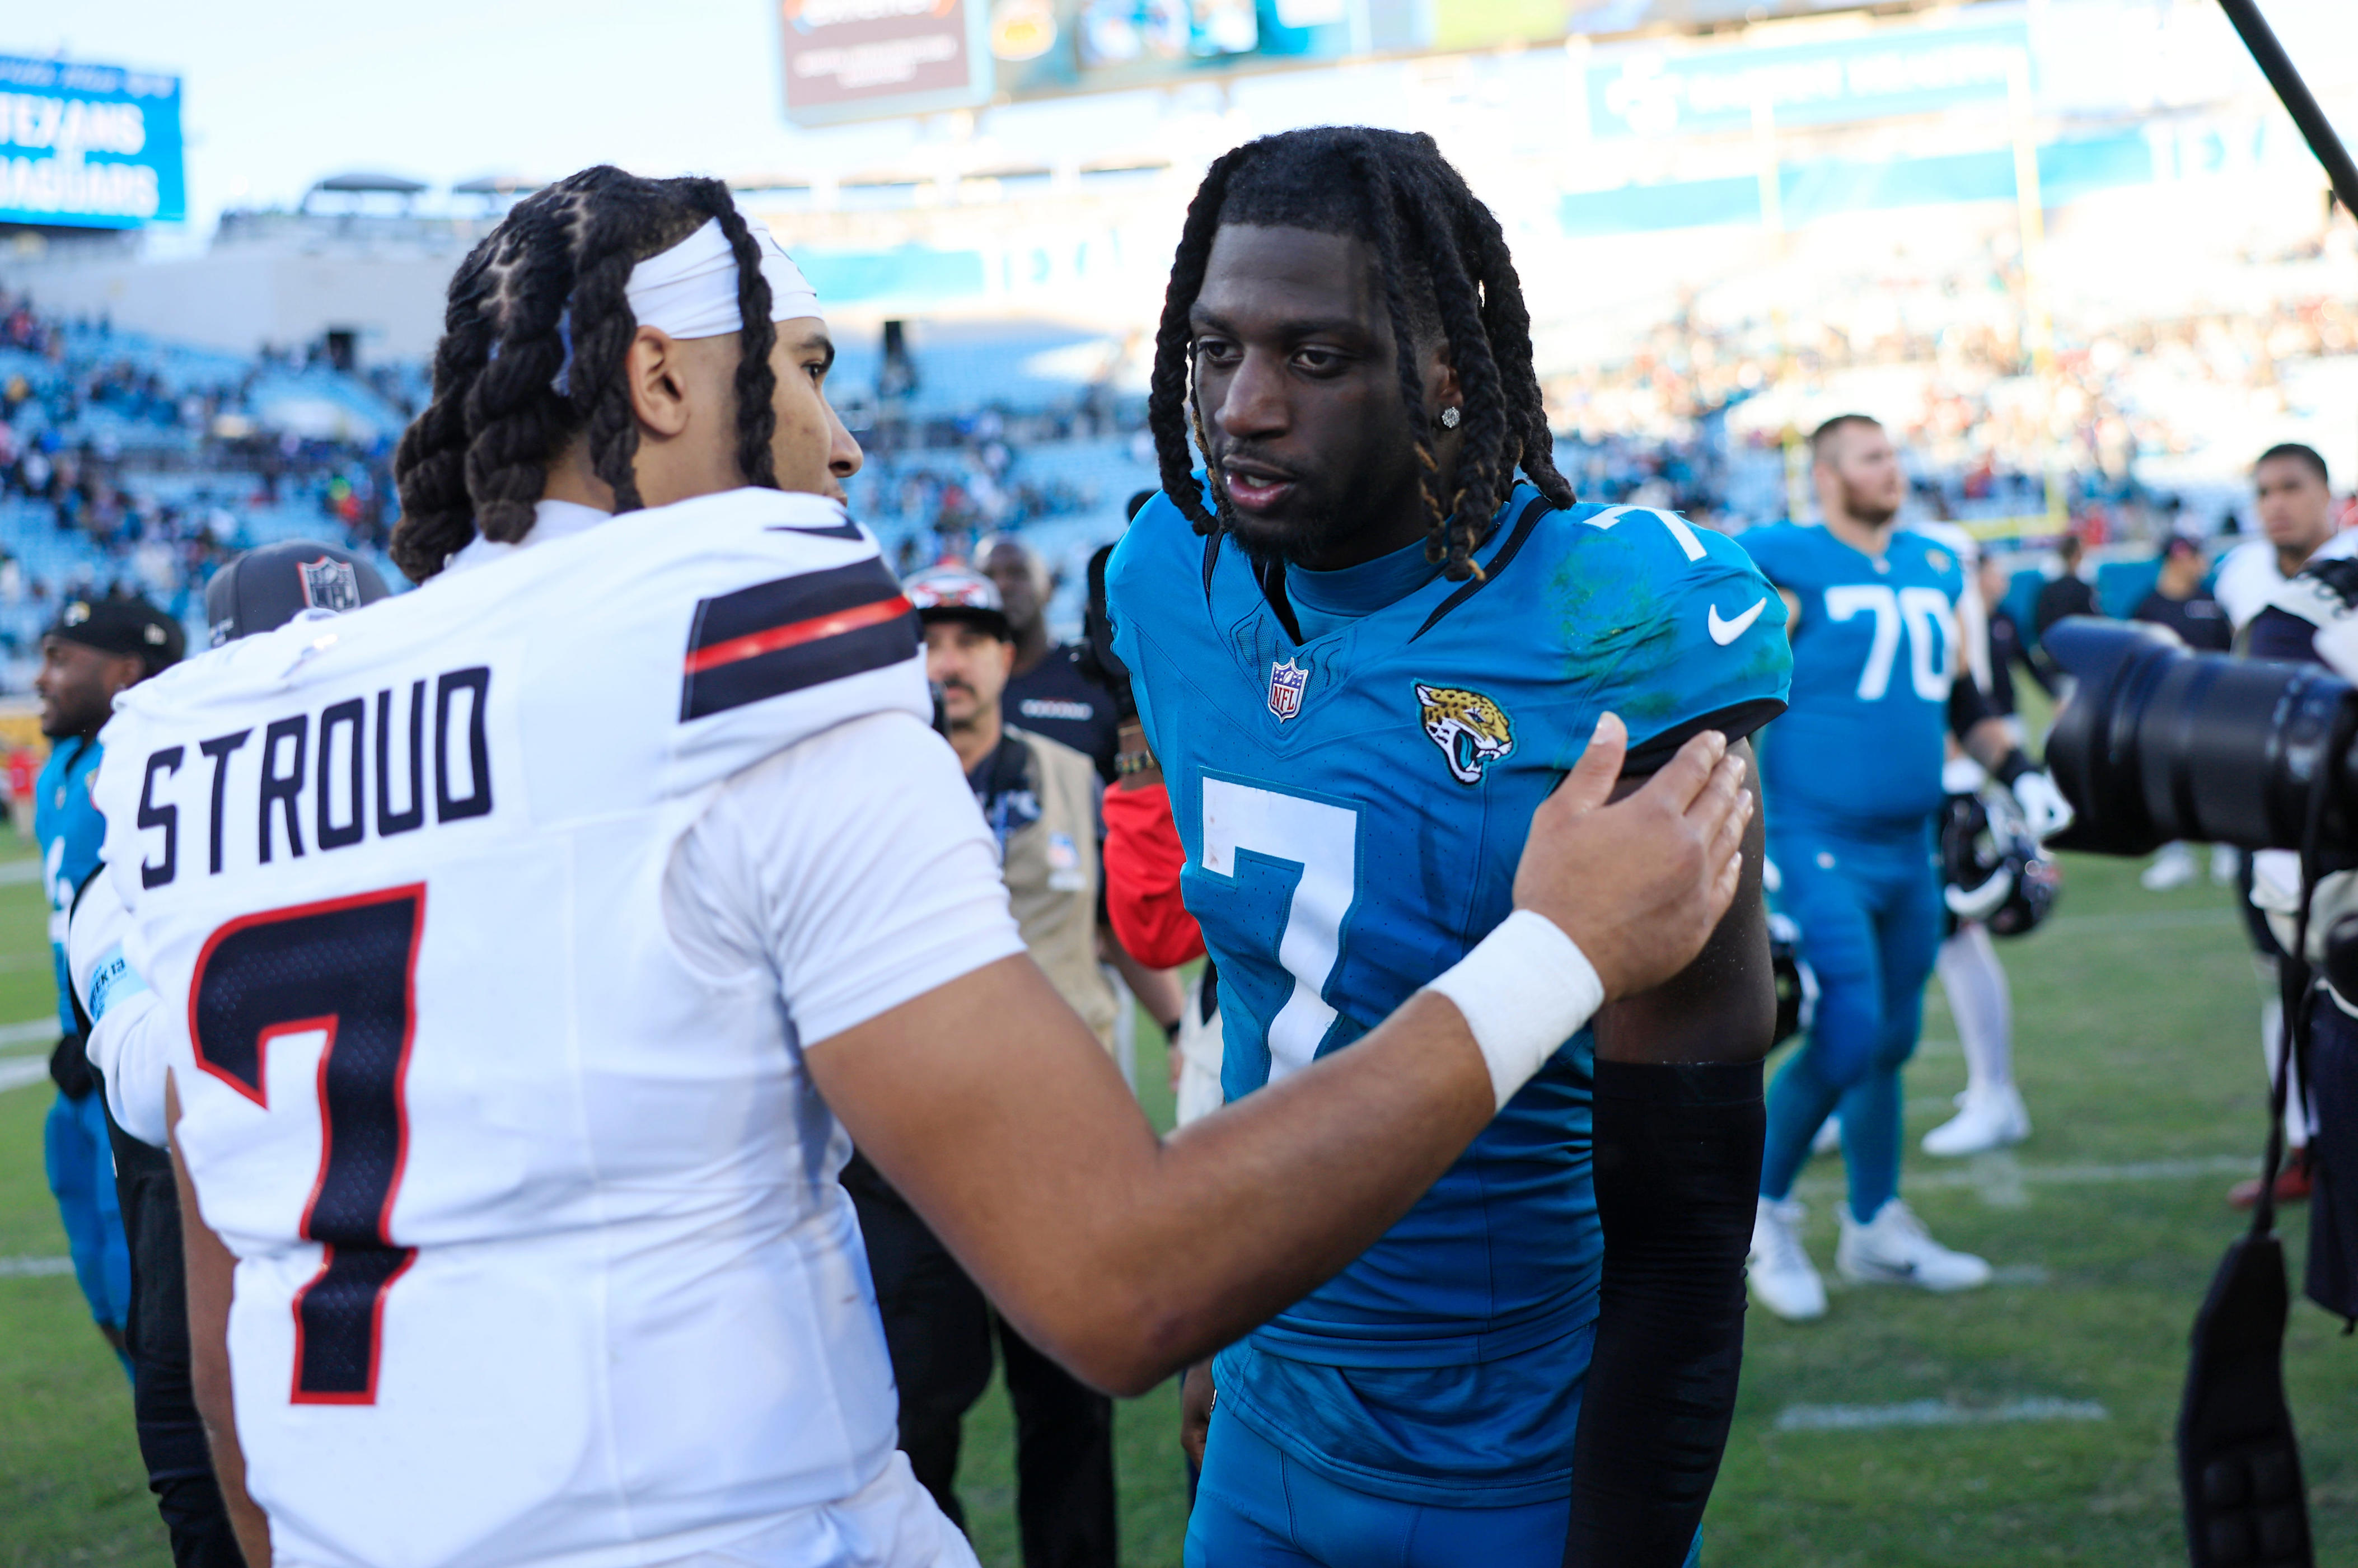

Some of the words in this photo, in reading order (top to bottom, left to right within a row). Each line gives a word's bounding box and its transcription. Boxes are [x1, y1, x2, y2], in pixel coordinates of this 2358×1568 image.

[1583, 505, 1707, 562] 7
[1272, 686, 1294, 712] NFL
[1823, 584, 1959, 702] 70
[138, 665, 493, 890] STROUD
[1202, 776, 1358, 1085] 7
[188, 881, 427, 1405] 7
